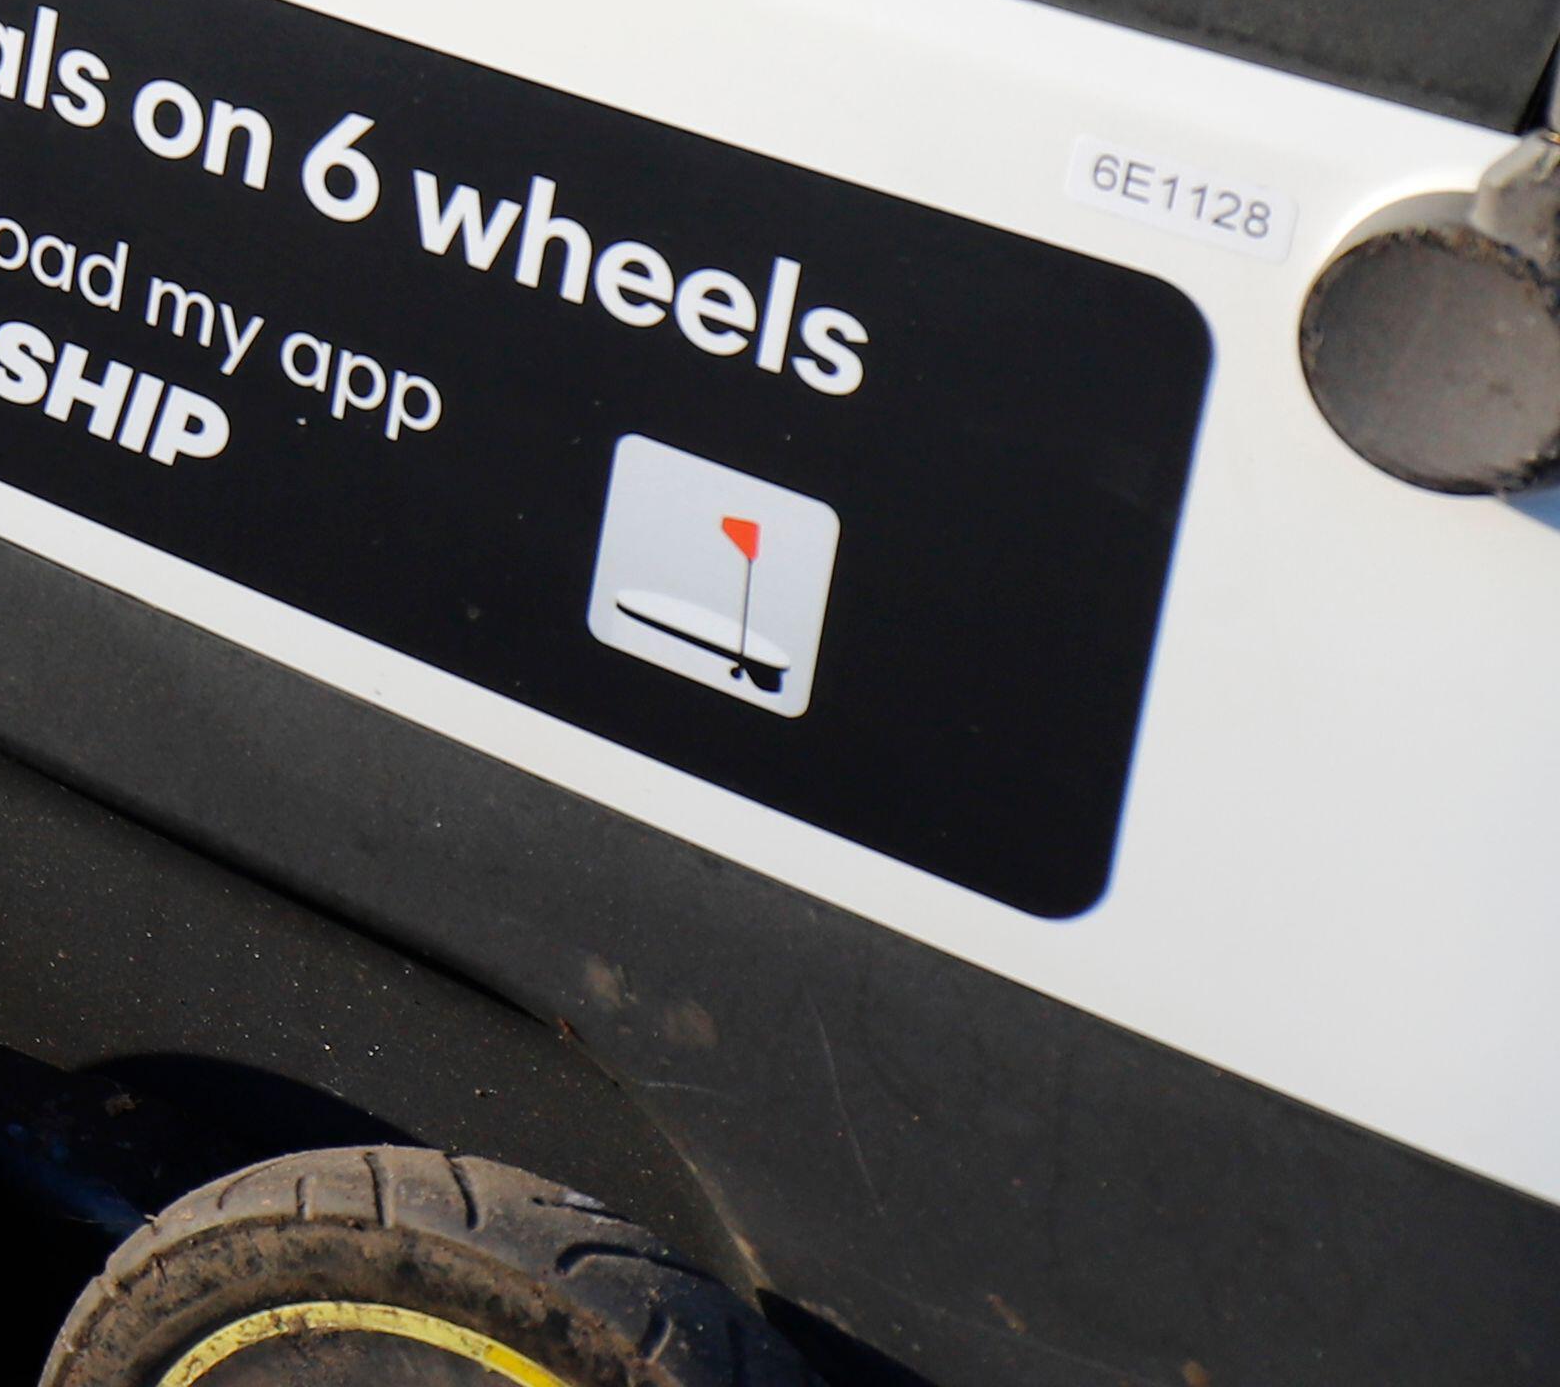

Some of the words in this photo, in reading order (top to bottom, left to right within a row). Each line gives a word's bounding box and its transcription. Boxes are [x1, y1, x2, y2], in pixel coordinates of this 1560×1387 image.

[131, 75, 277, 192] on
[301, 113, 380, 224] 6
[414, 166, 873, 399] wheels
[1092, 153, 1272, 240] 6E1128
[146, 271, 266, 375] my
[281, 332, 444, 442] app
